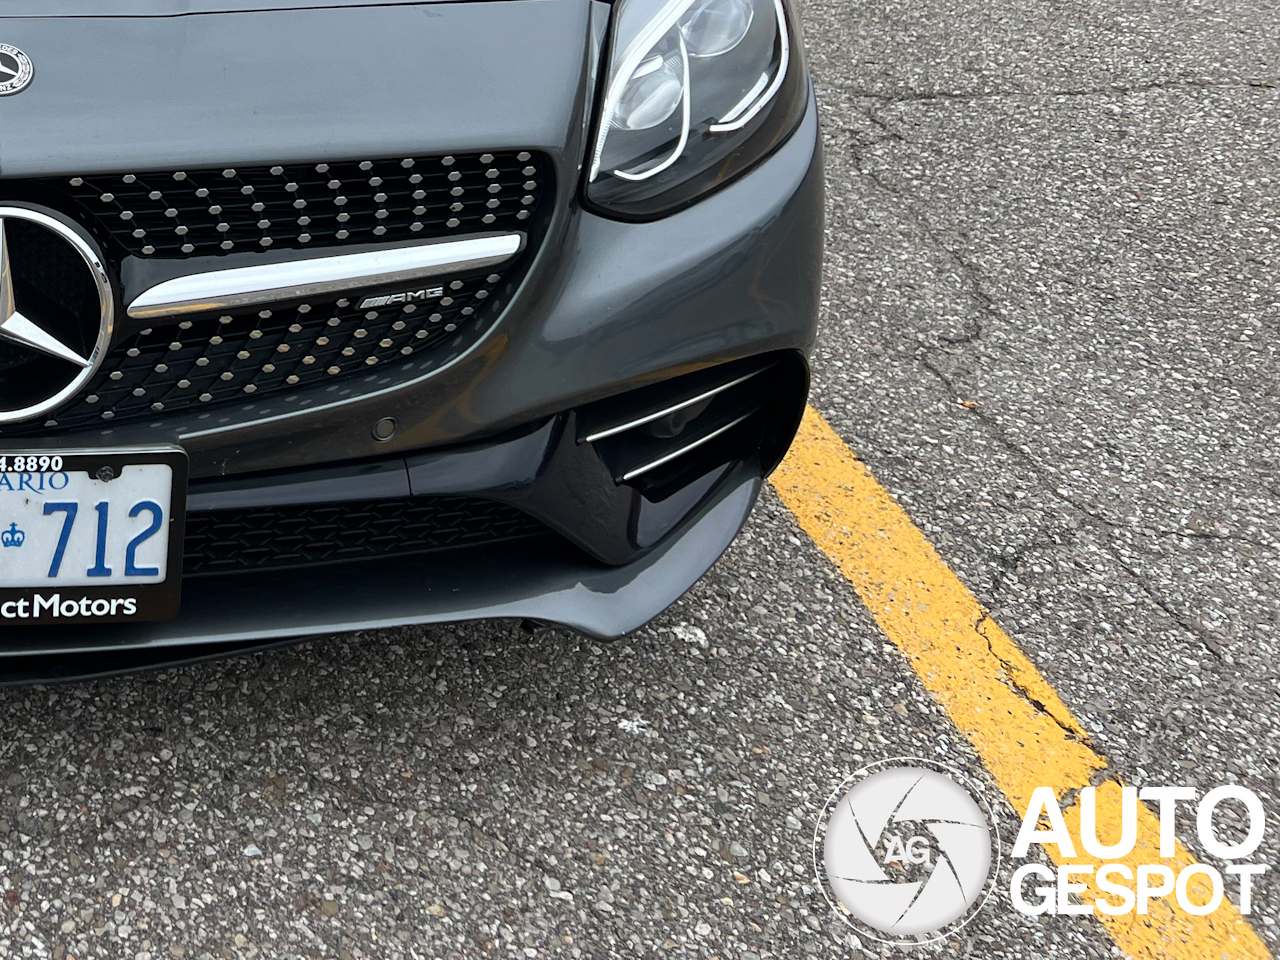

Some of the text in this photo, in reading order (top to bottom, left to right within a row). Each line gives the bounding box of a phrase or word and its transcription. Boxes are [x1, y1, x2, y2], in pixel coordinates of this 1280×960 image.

[385, 287, 444, 305] AMG
[43, 500, 164, 577] 712
[33, 593, 137, 618] Motors
